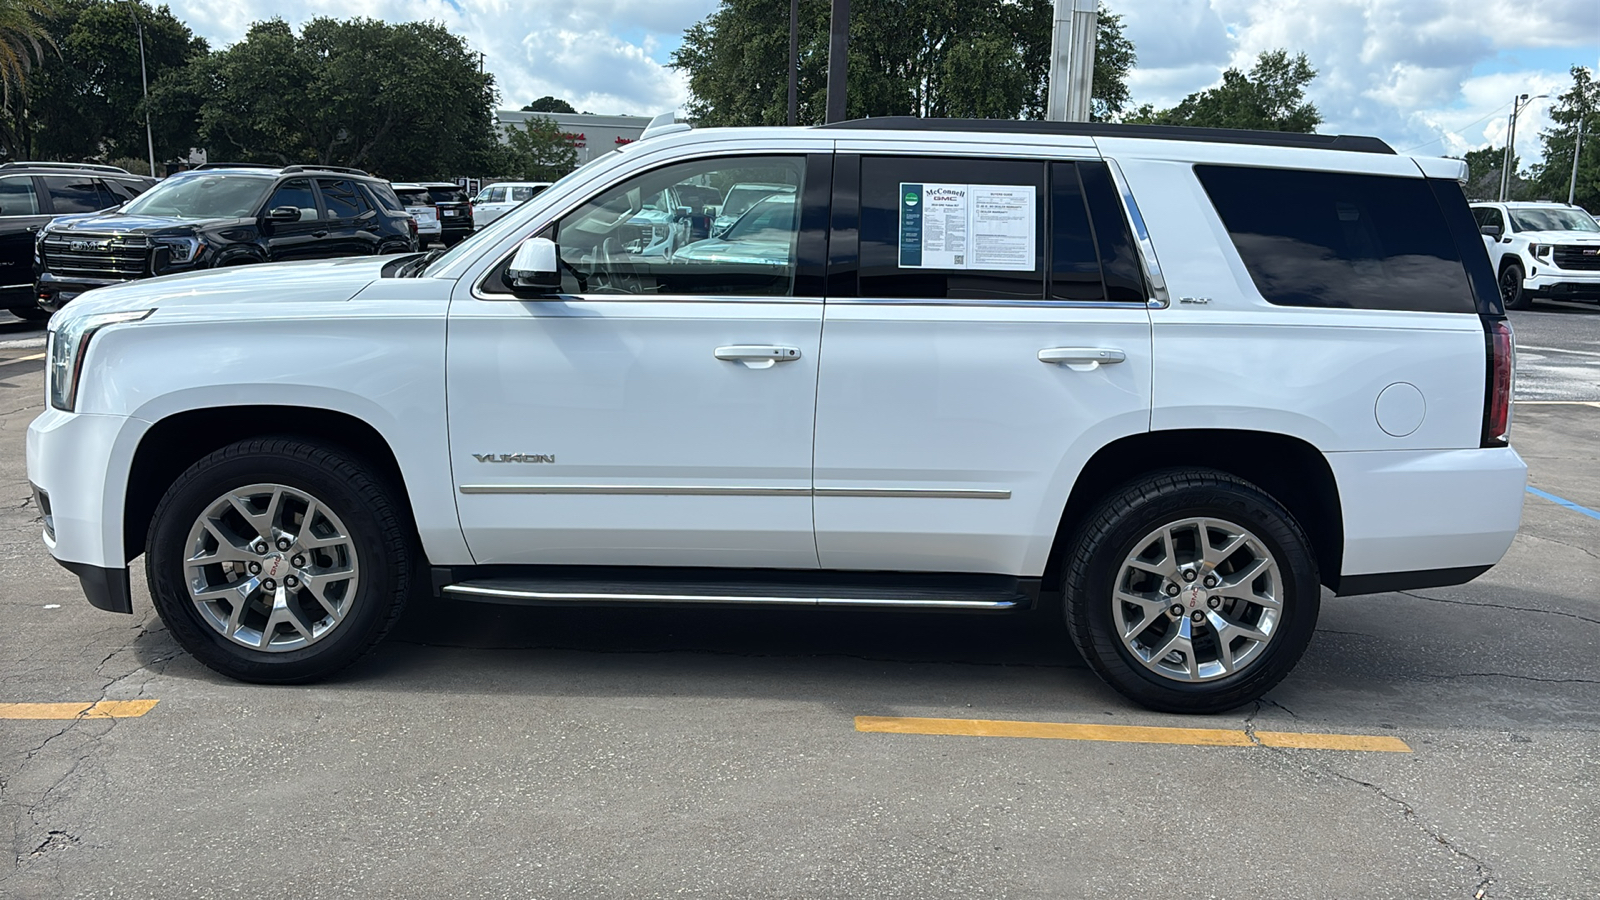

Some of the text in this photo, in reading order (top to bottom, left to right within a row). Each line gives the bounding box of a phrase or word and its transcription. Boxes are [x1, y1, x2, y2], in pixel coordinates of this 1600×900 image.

[926, 187, 965, 197] McConnell
[71, 241, 109, 252] GMC
[1179, 296, 1212, 304] SLT
[472, 453, 556, 464] YUKON
[269, 554, 282, 576] GMC
[1189, 586, 1200, 608] GMC
